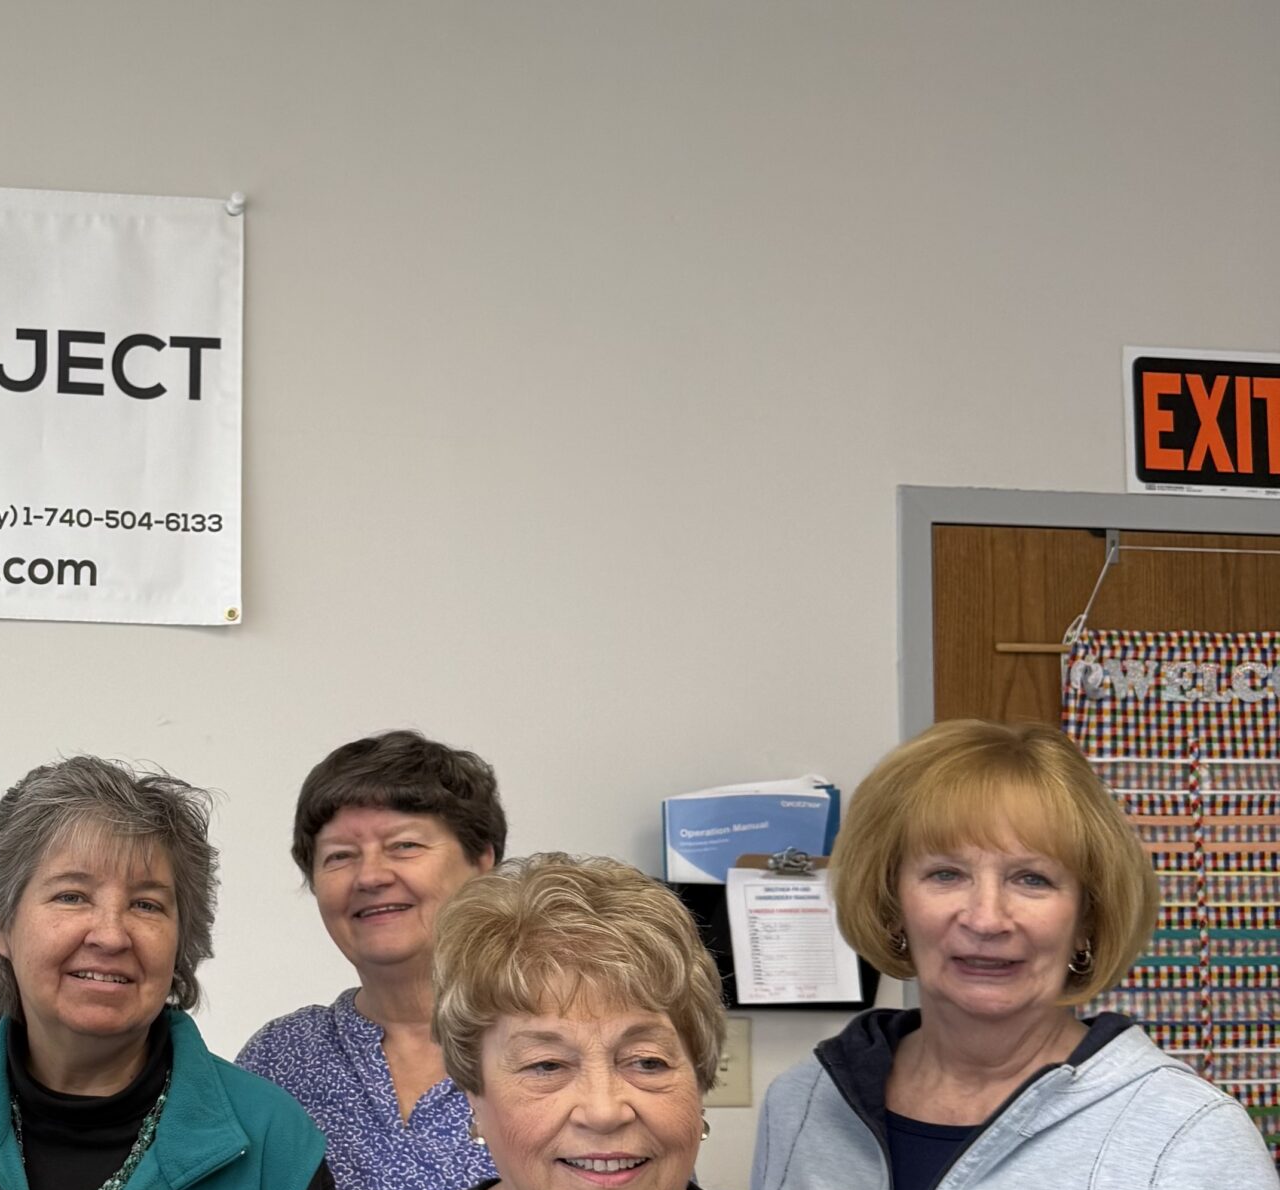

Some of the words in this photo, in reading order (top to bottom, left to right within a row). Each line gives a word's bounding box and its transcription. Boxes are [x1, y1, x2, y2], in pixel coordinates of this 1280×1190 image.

[1142, 371, 1280, 474] EXIT
[22, 506, 222, 532] 1-740-504-6133
[680, 827, 730, 838] Operation
[732, 821, 769, 832] Manual
